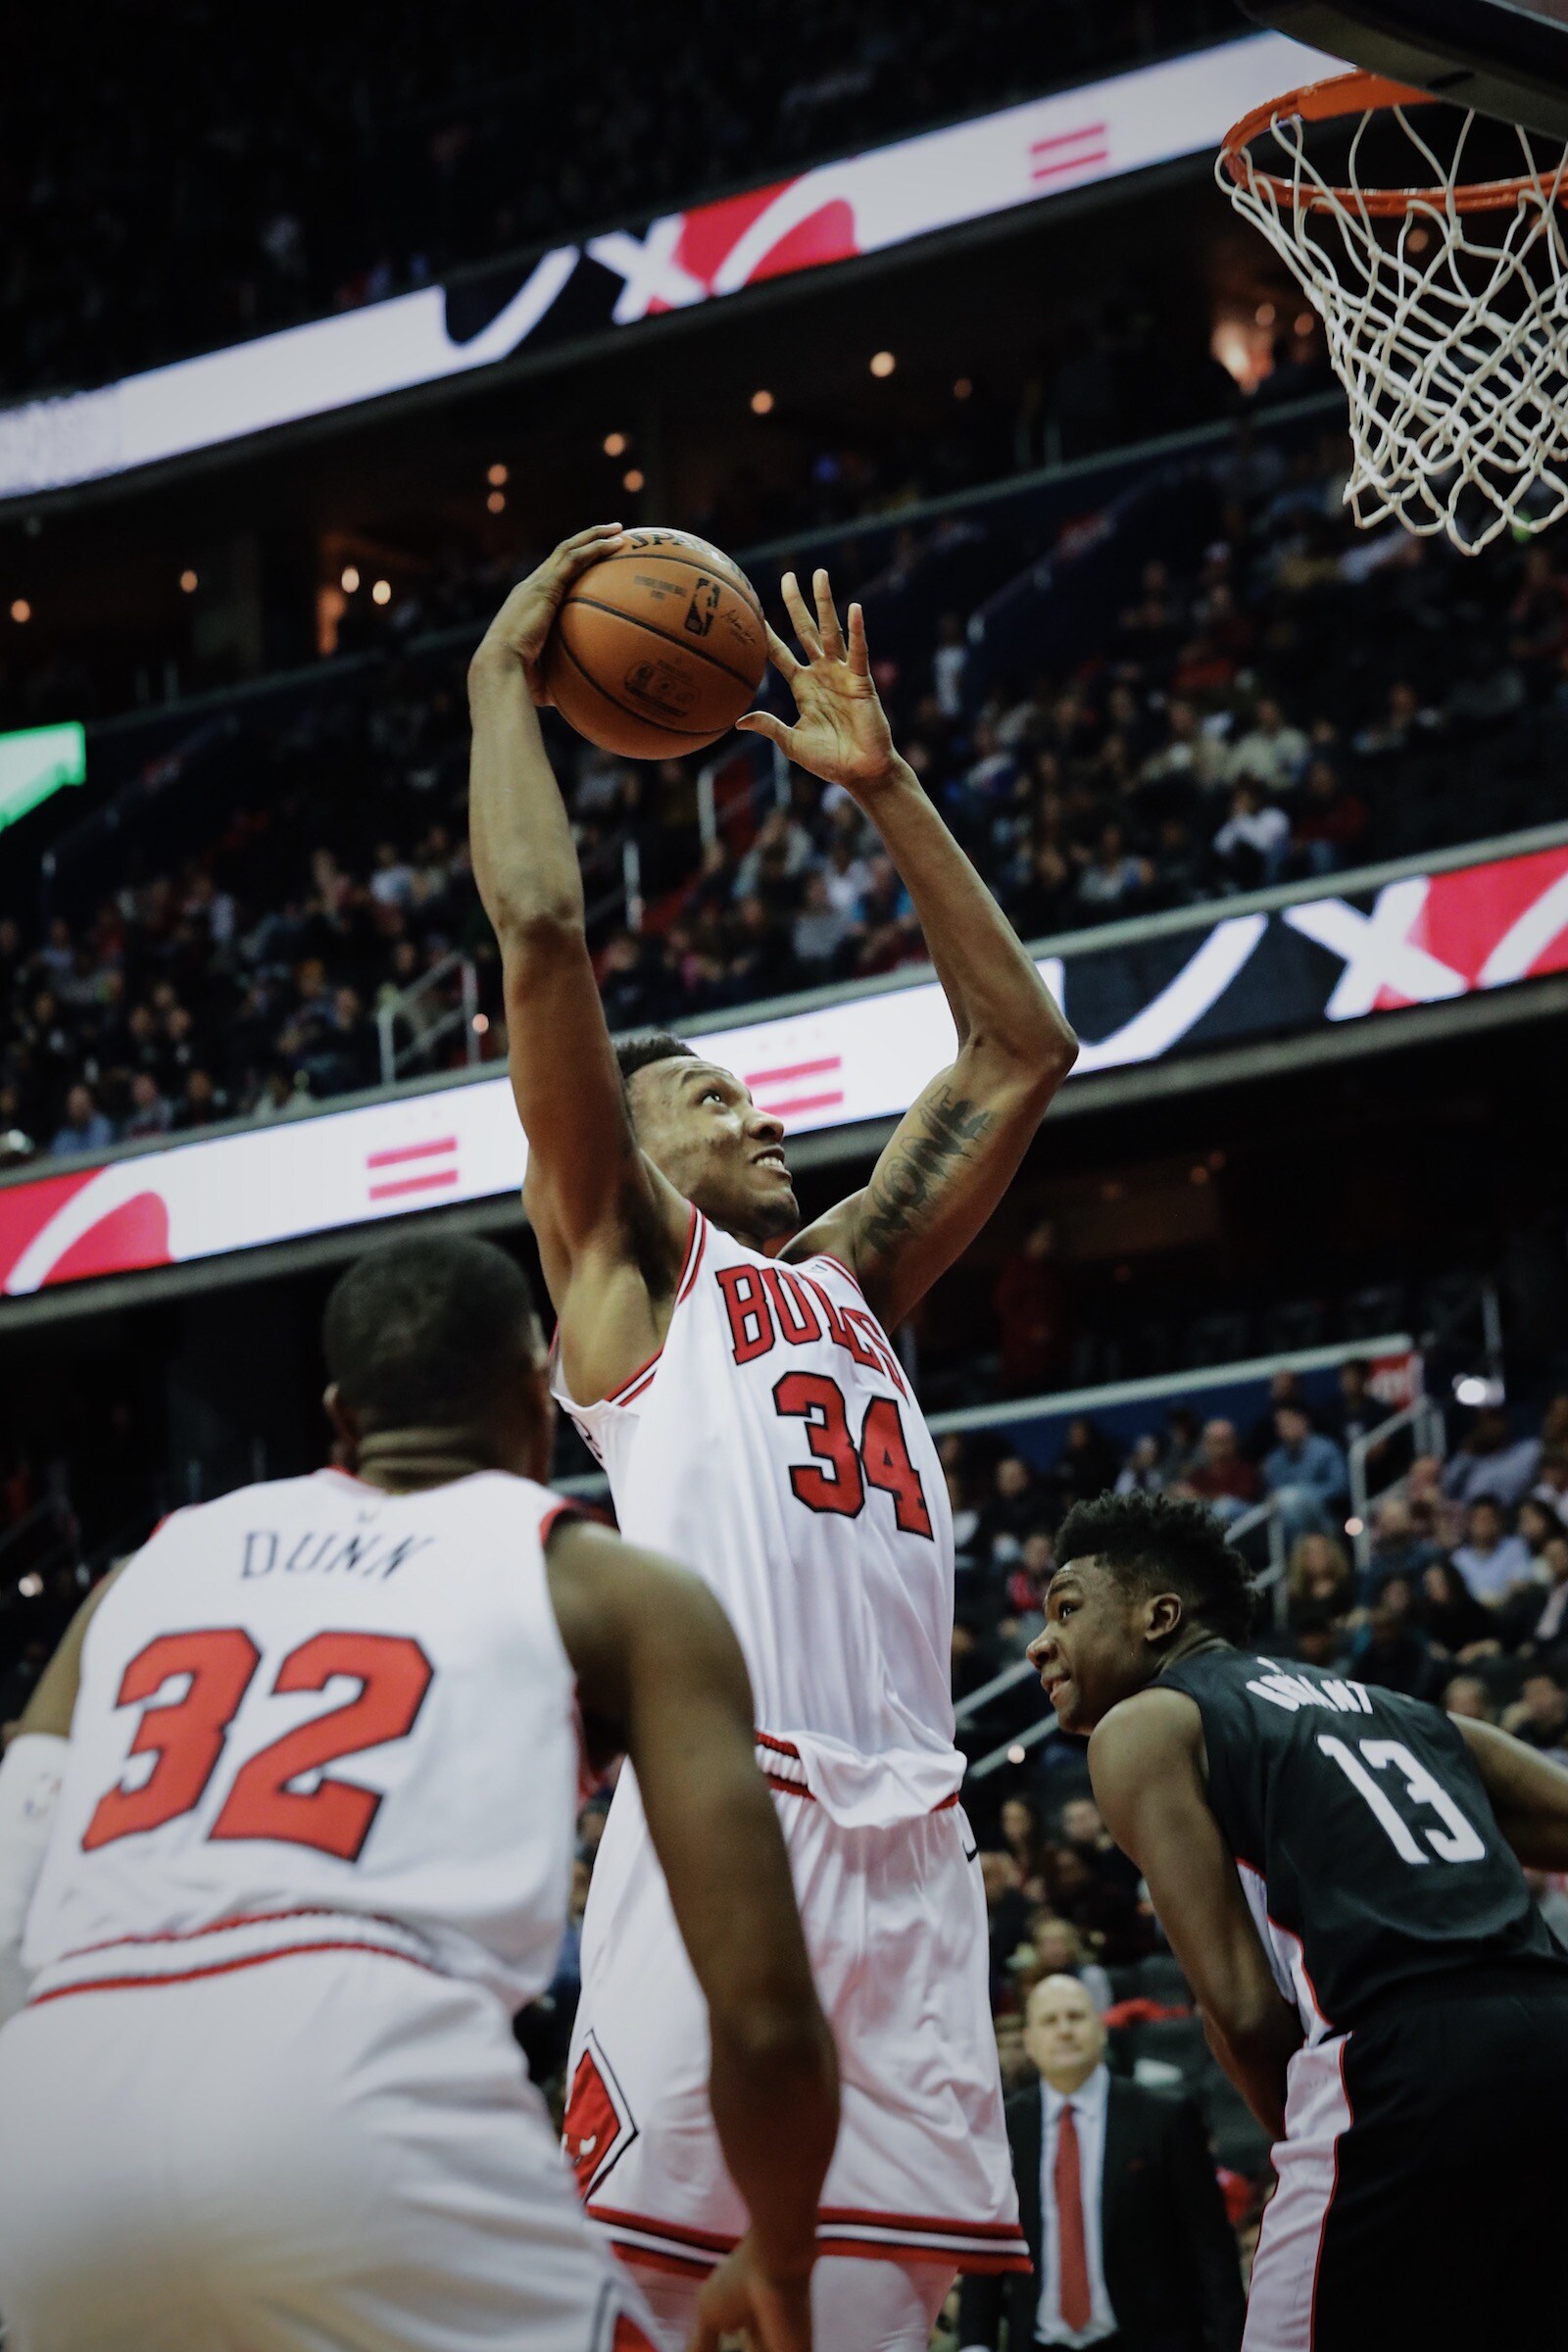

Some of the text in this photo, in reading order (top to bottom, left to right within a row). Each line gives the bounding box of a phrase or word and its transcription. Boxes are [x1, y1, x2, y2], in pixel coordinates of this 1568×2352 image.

[861, 1084, 992, 1256] NONE
[772, 1371, 934, 1542] 34
[241, 1530, 436, 1580] DUNN
[80, 1626, 434, 1864] 32
[1316, 1734, 1486, 1864] 13
